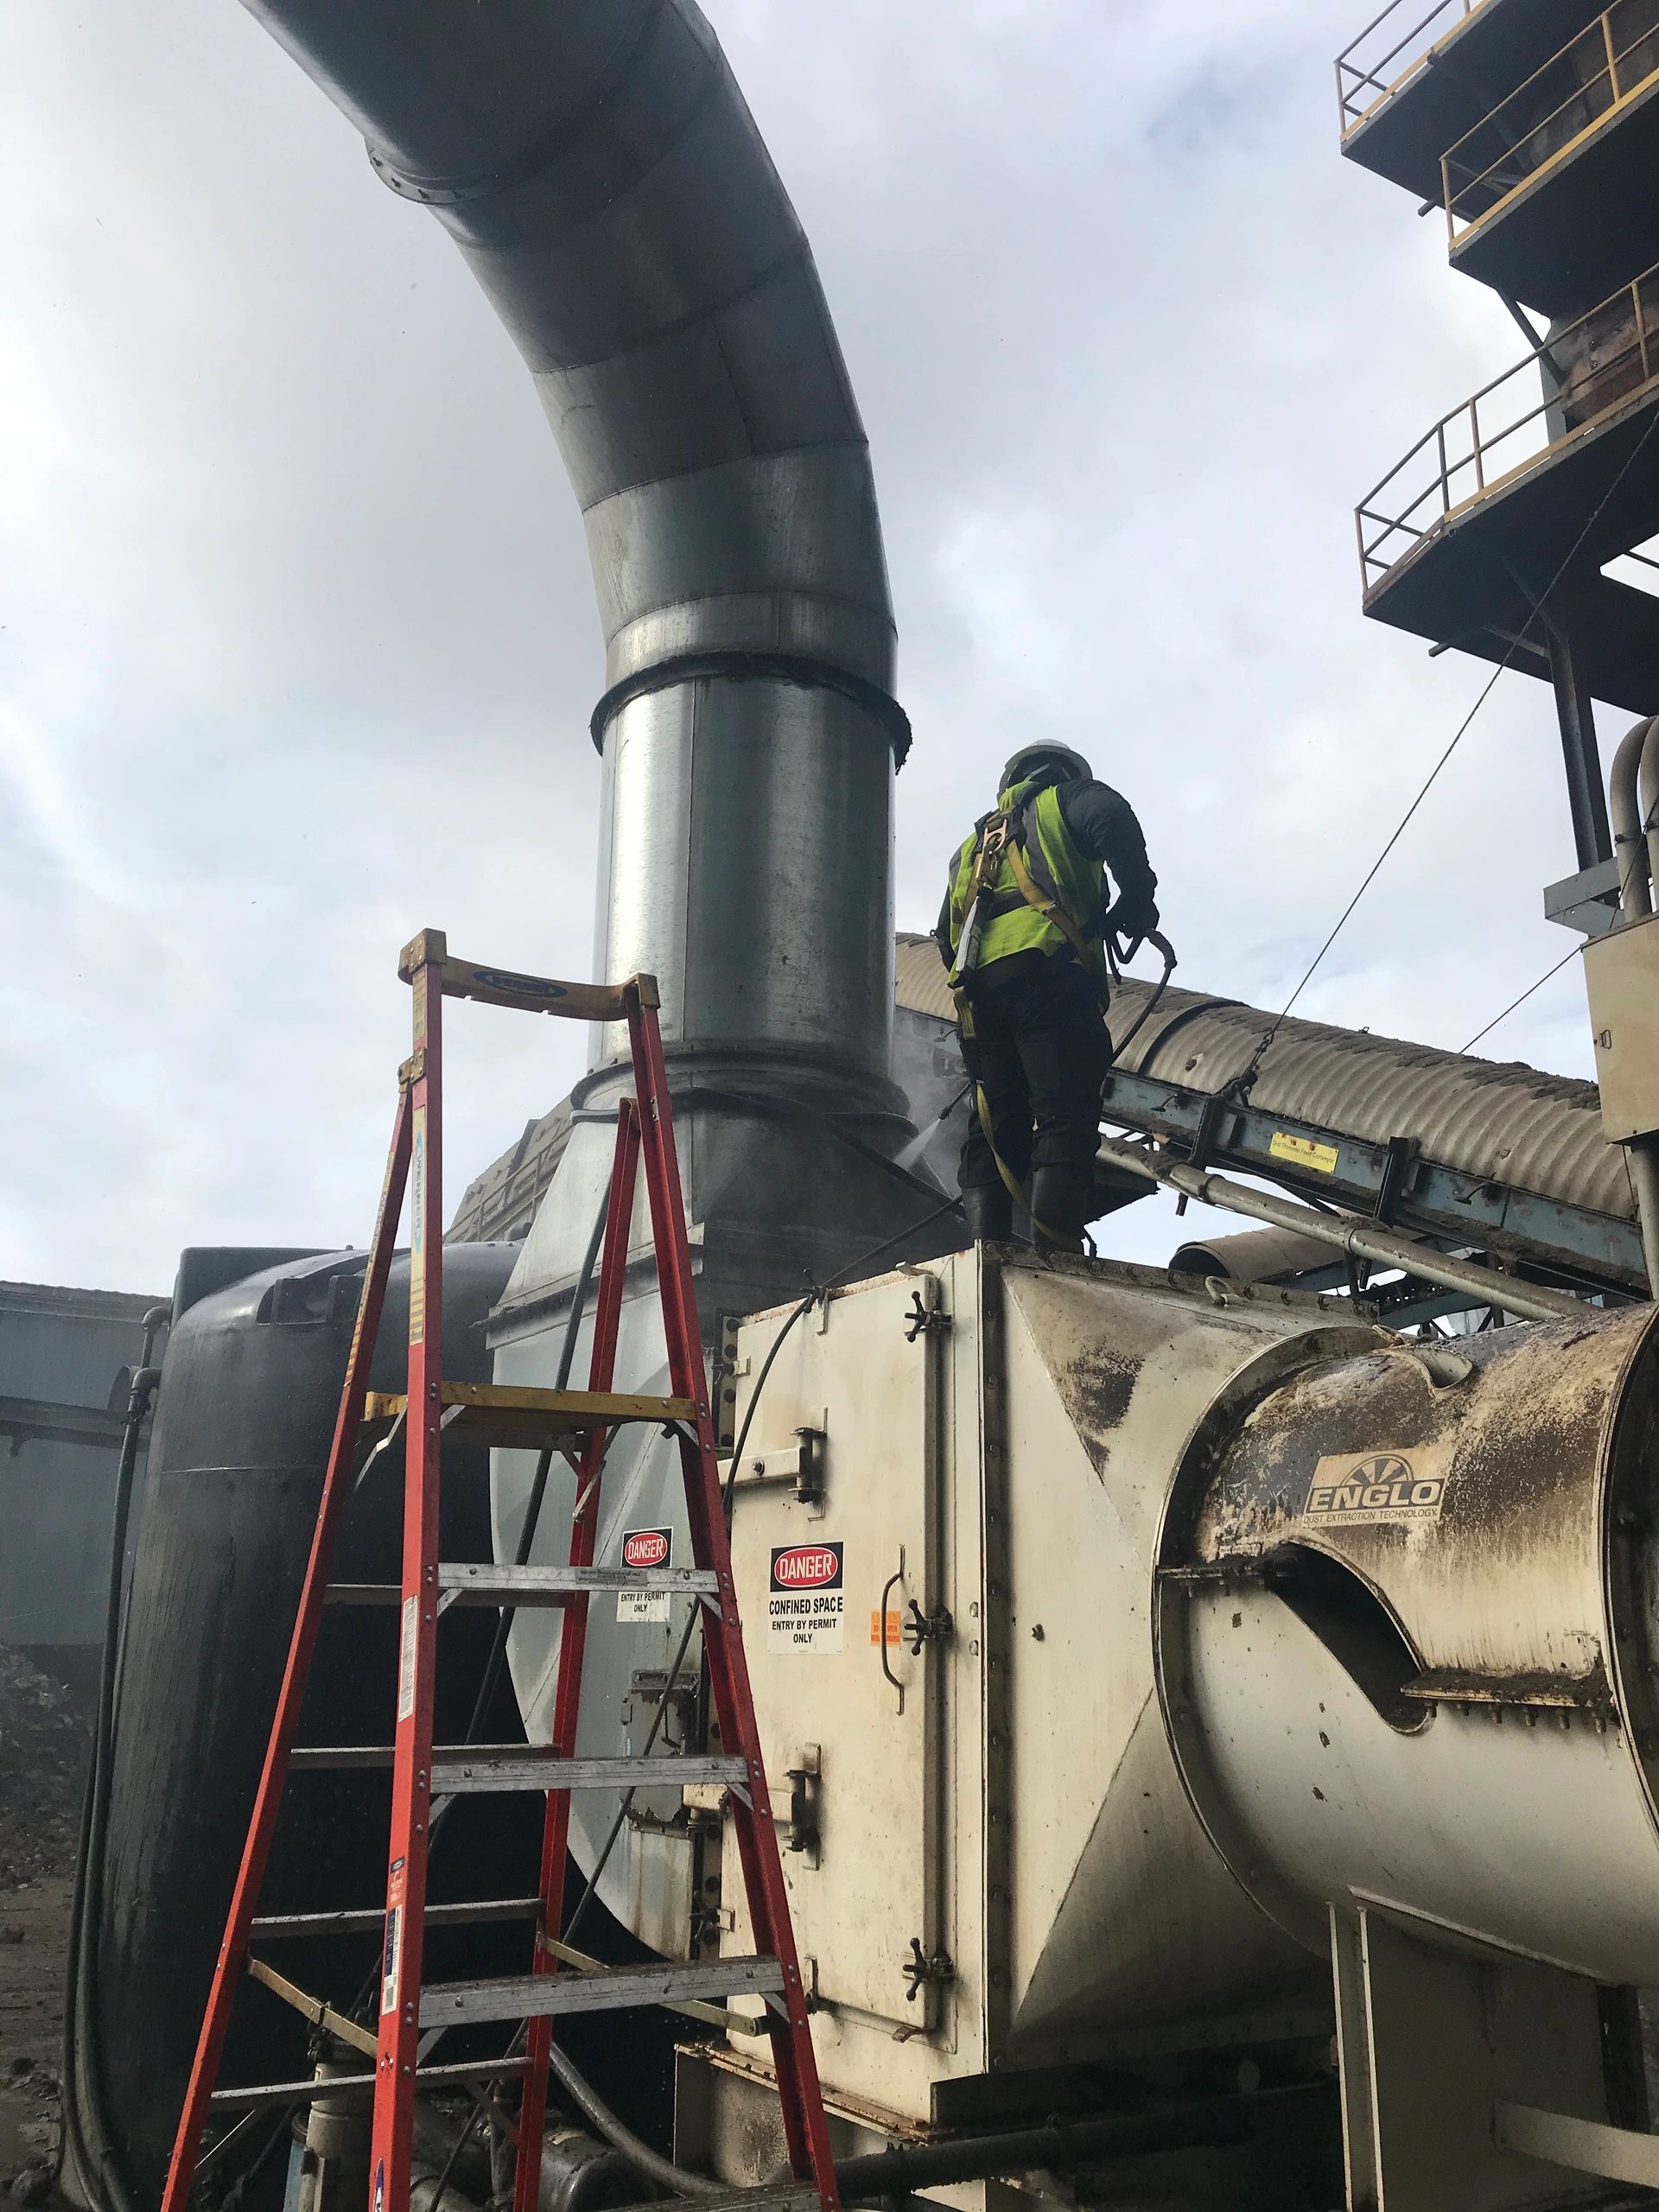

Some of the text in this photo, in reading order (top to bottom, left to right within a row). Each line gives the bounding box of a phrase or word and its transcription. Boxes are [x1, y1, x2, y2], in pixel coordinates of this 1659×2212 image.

[1310, 1481, 1441, 1512] ENGLO
[1303, 1515, 1323, 1525] DUST
[1326, 1512, 1376, 1522] EXTRACTION
[627, 1538, 664, 1560] DANGER
[779, 1554, 832, 1580] DANGER
[620, 1592, 665, 1602] ENTRY BY PERMIT
[633, 1604, 648, 1612] ONLY
[769, 1596, 843, 1615] CONFINED SPACE
[772, 1618, 837, 1630] ENTRY BY PERMIT
[793, 1633, 813, 1643] ONLY
